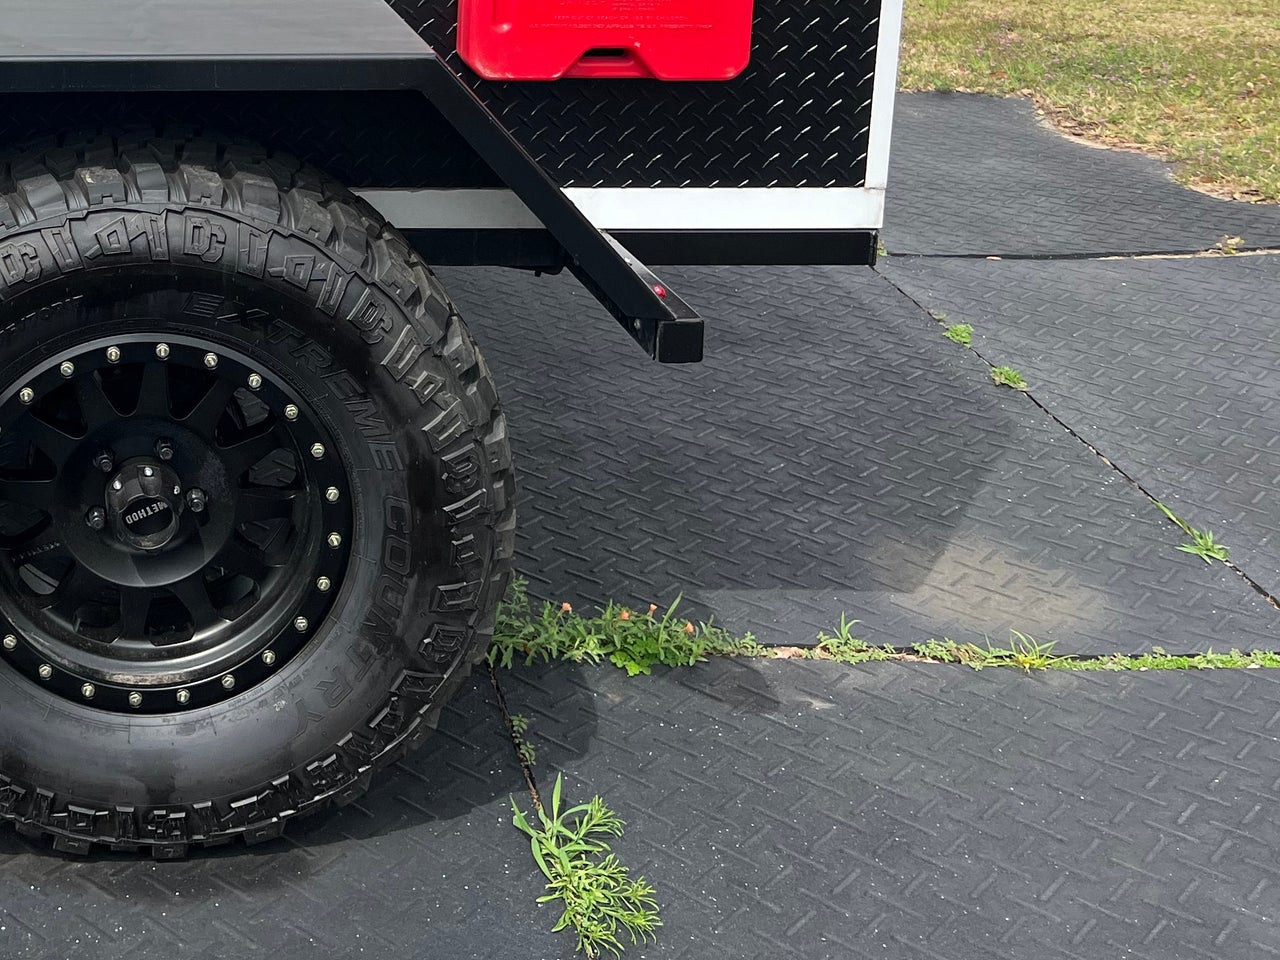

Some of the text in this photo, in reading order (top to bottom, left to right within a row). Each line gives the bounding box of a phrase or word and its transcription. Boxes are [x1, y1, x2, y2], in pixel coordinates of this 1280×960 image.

[180, 290, 405, 472] EXTREME
[124, 501, 169, 525] METHOD
[294, 495, 414, 739] COUNTRY
